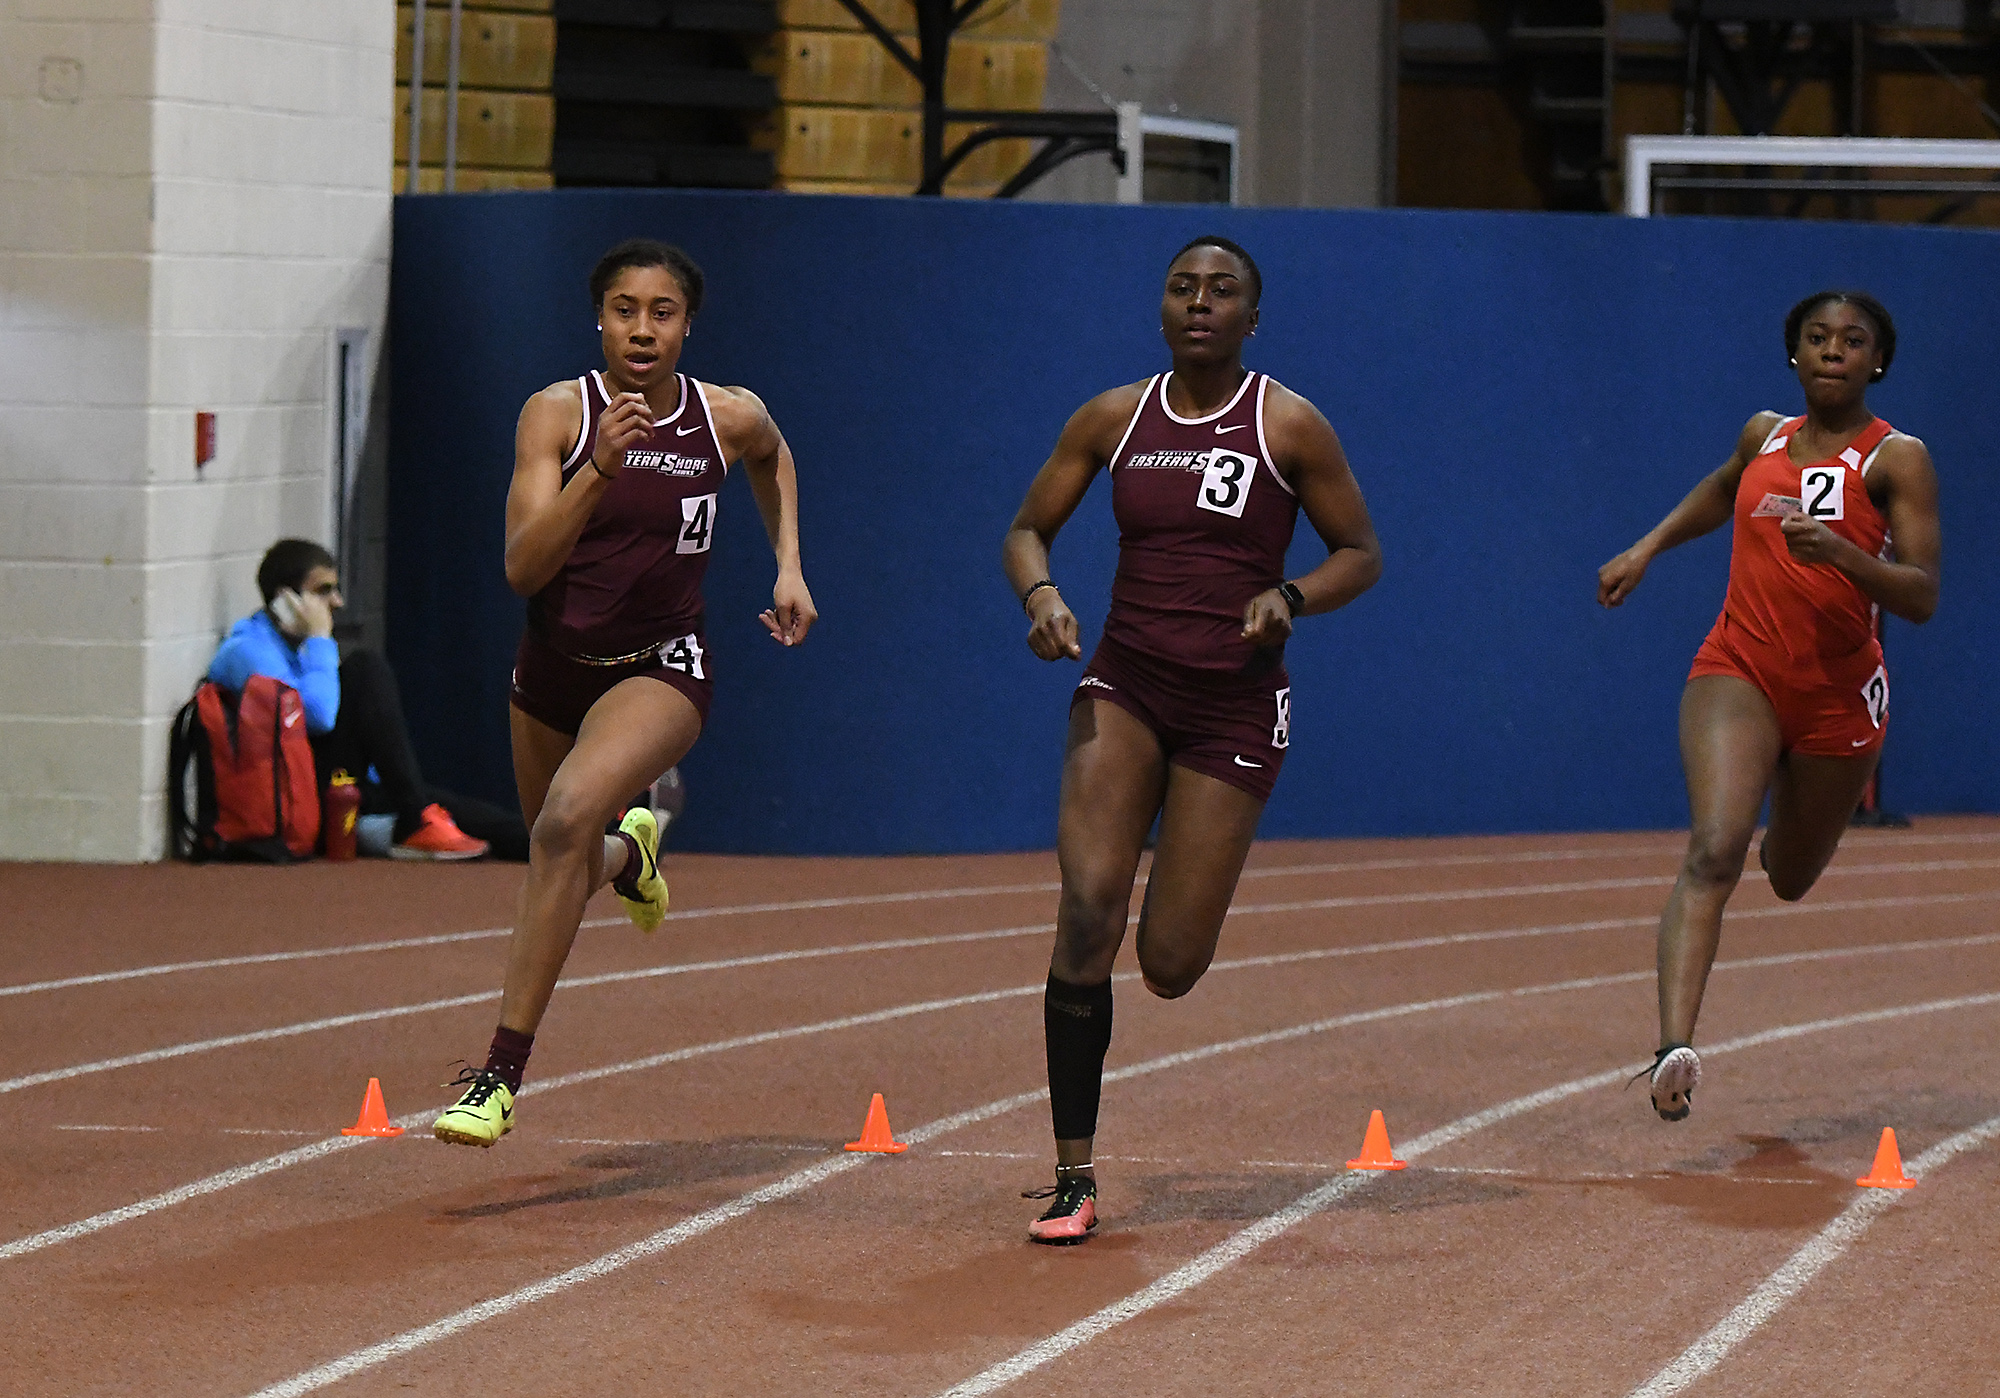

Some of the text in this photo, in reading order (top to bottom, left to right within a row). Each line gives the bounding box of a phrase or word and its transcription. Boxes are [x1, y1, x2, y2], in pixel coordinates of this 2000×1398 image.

[625, 454, 709, 472] TERN SHORE
[1128, 455, 1194, 467] EASTERN
[1206, 455, 1245, 508] 3
[1807, 472, 1836, 516] 2
[682, 499, 709, 549] 4
[667, 637, 695, 675] 4
